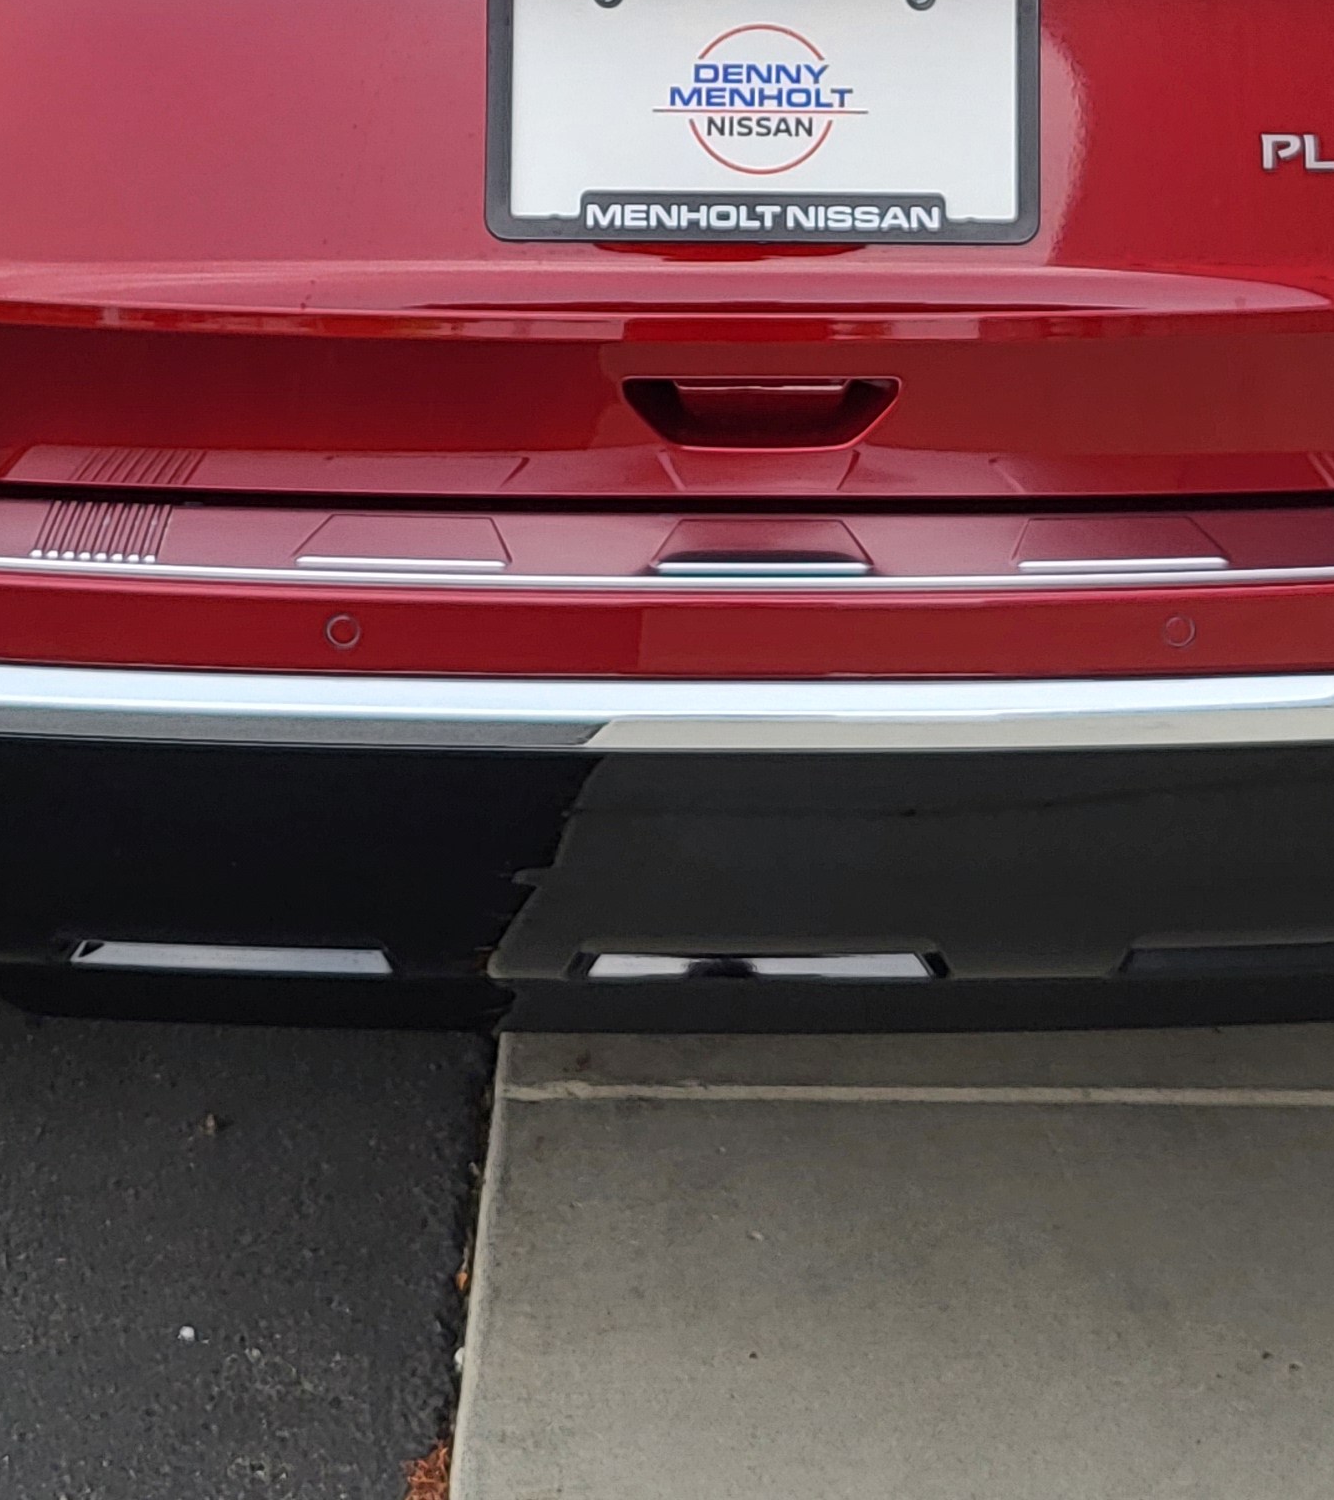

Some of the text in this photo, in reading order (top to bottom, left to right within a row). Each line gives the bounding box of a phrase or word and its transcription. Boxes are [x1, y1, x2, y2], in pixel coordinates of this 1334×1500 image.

[694, 64, 830, 85] DENNY
[670, 87, 854, 108] MENHOLT
[706, 116, 813, 138] NISSAN
[586, 204, 940, 231] MENHOLT NISSAN
